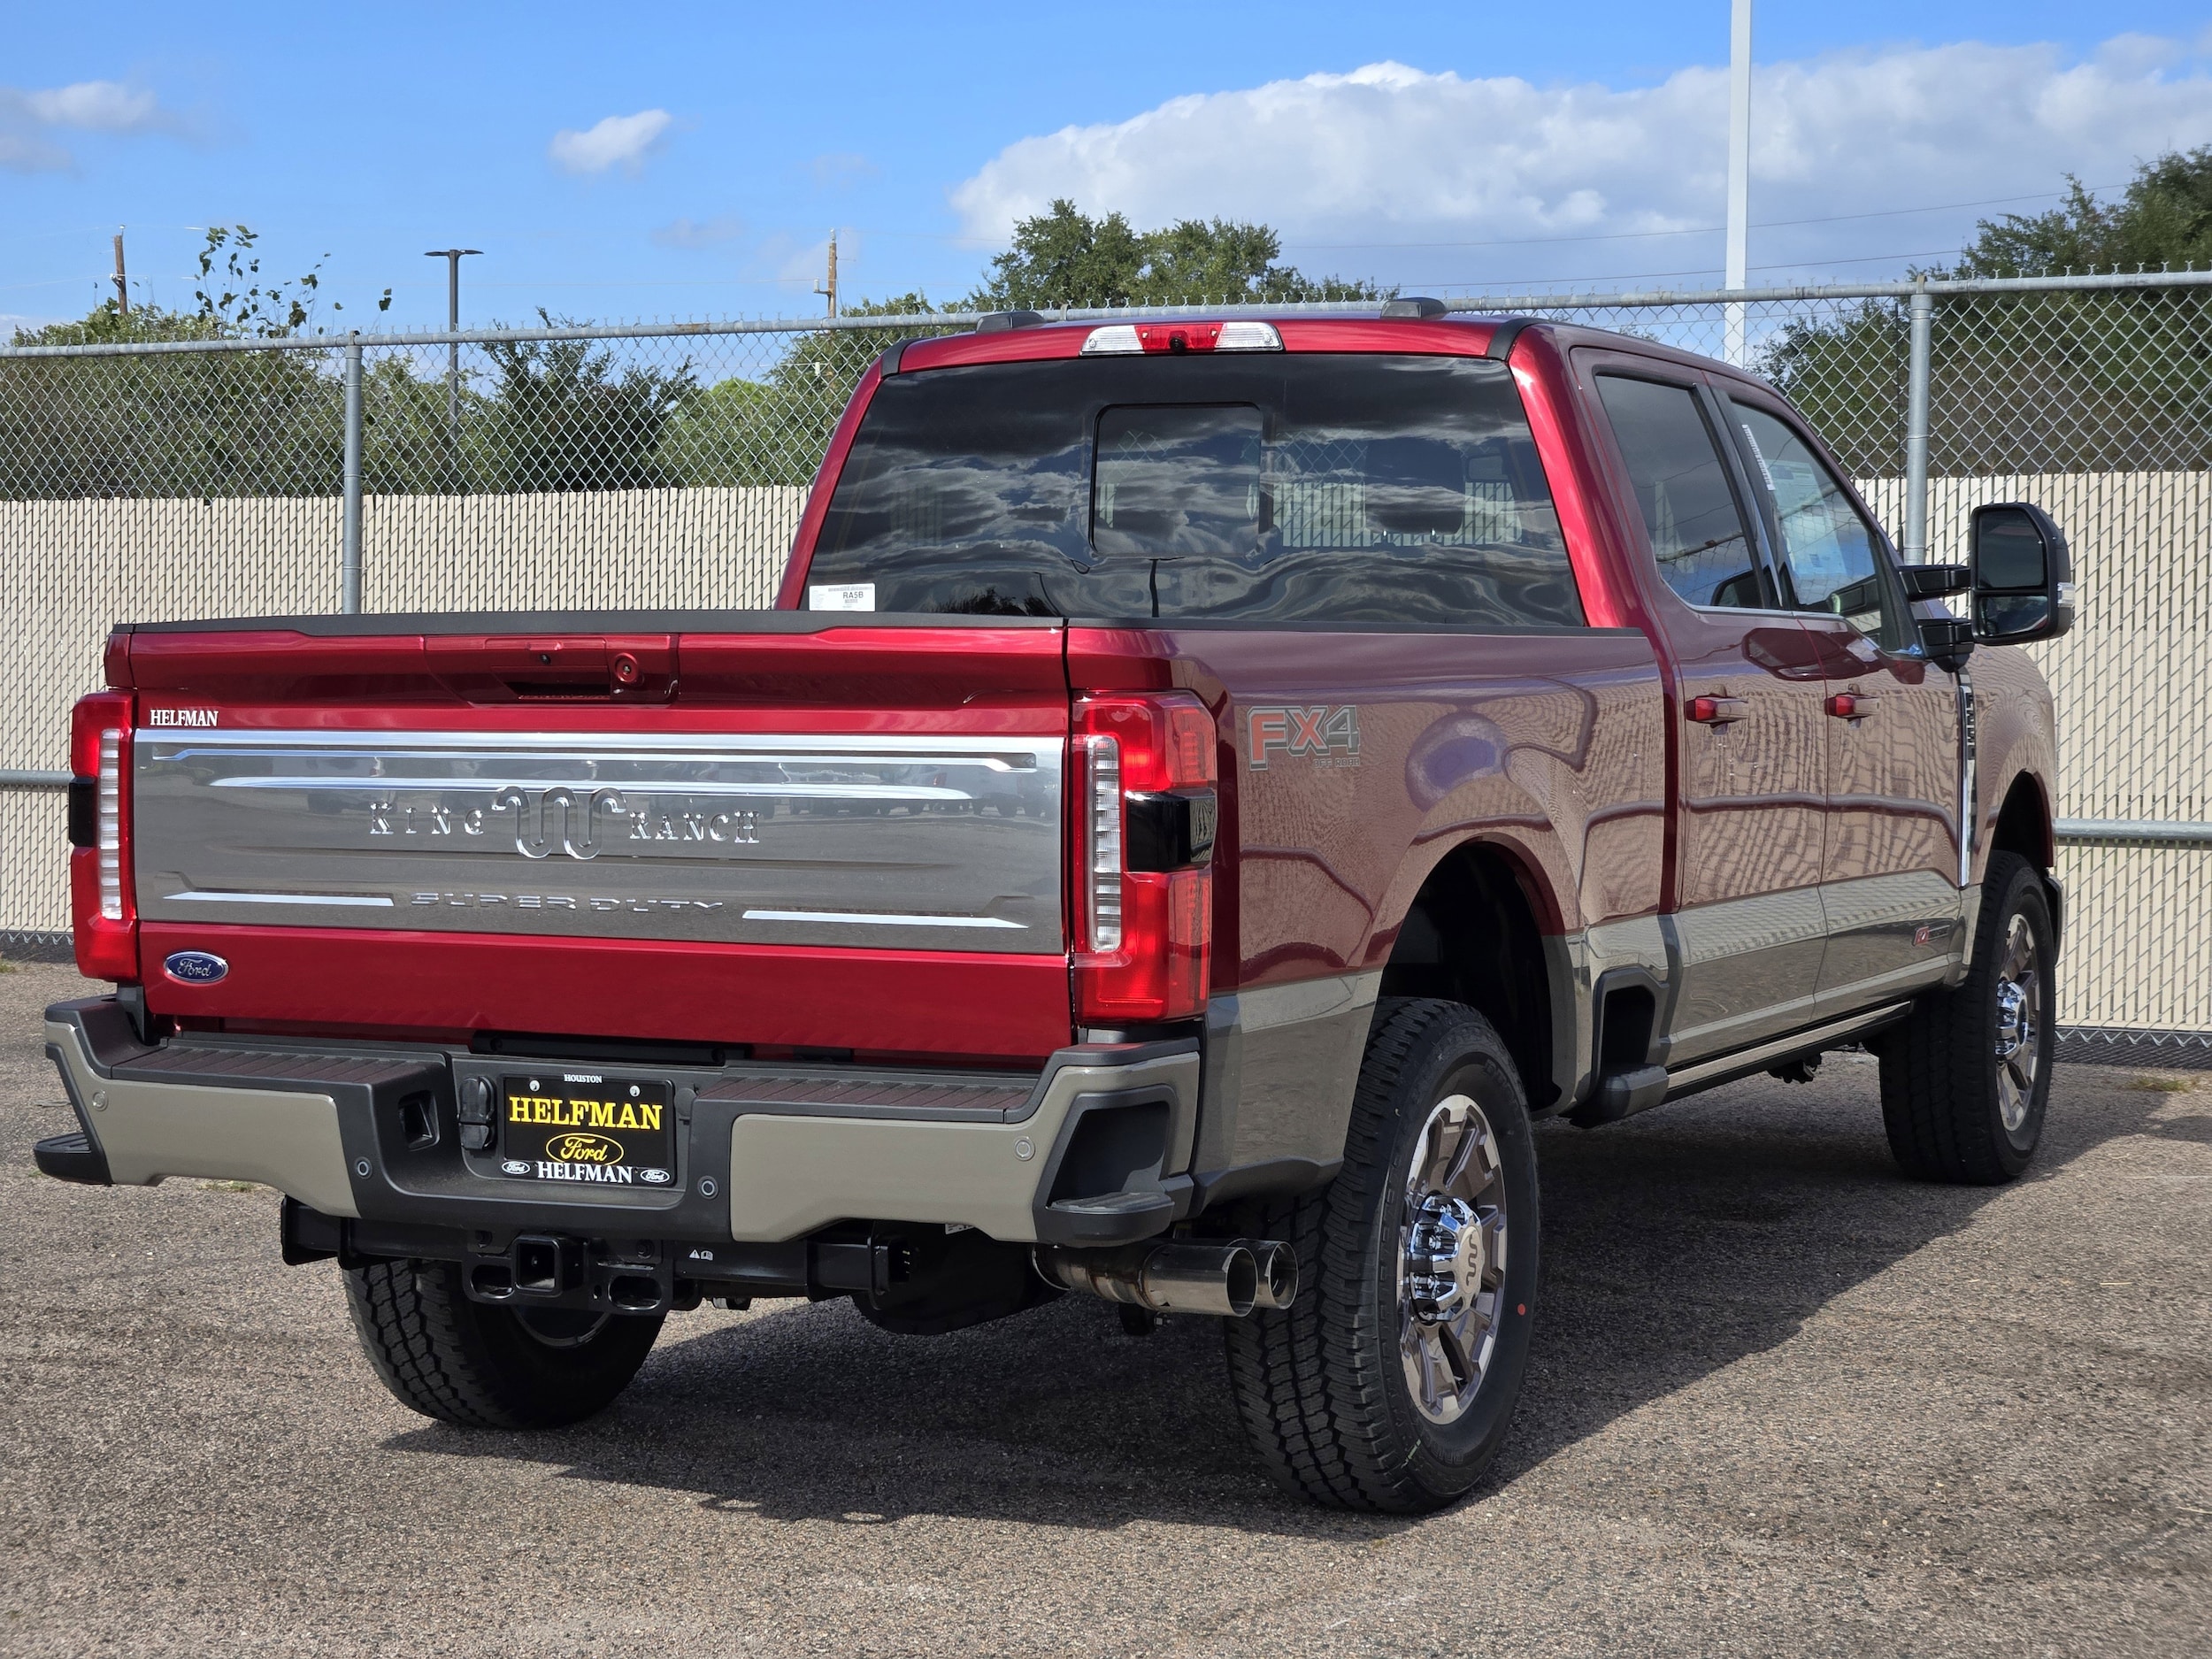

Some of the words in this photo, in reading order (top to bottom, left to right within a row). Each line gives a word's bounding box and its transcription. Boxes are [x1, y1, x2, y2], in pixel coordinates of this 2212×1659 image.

[150, 709, 219, 727] HELFMAN
[1247, 705, 1361, 771] FX4
[369, 802, 485, 836] KING
[628, 810, 761, 844] RANCH
[410, 892, 577, 911] SUPER
[589, 896, 725, 916] DUTY
[177, 958, 211, 977] Ford
[564, 1073, 603, 1084] HOUSTON
[509, 1095, 664, 1131] HELFMAN
[560, 1135, 608, 1163] Ford
[506, 1162, 525, 1172] Ford
[537, 1161, 634, 1184] HELFMAN
[646, 1171, 665, 1181] Ford
